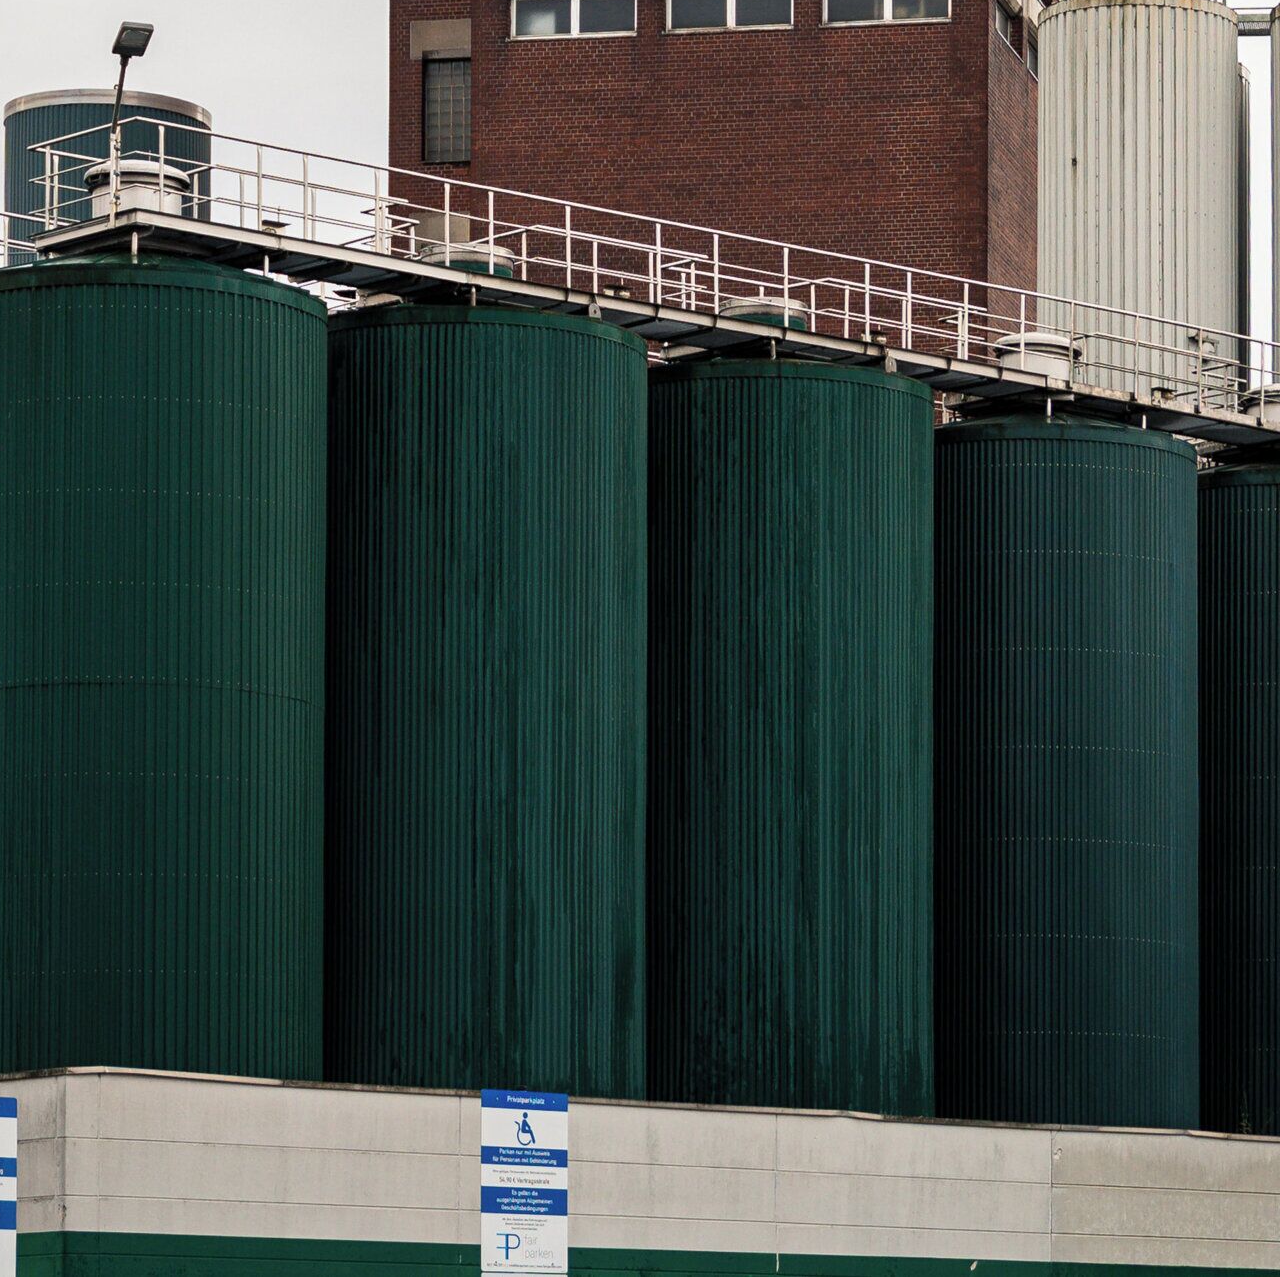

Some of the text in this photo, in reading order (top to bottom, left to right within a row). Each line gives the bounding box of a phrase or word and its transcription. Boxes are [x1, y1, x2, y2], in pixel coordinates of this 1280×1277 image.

[507, 1095, 545, 1104] Privatparkplatz
[524, 1234, 538, 1245] fair
[525, 1248, 554, 1259] parken
